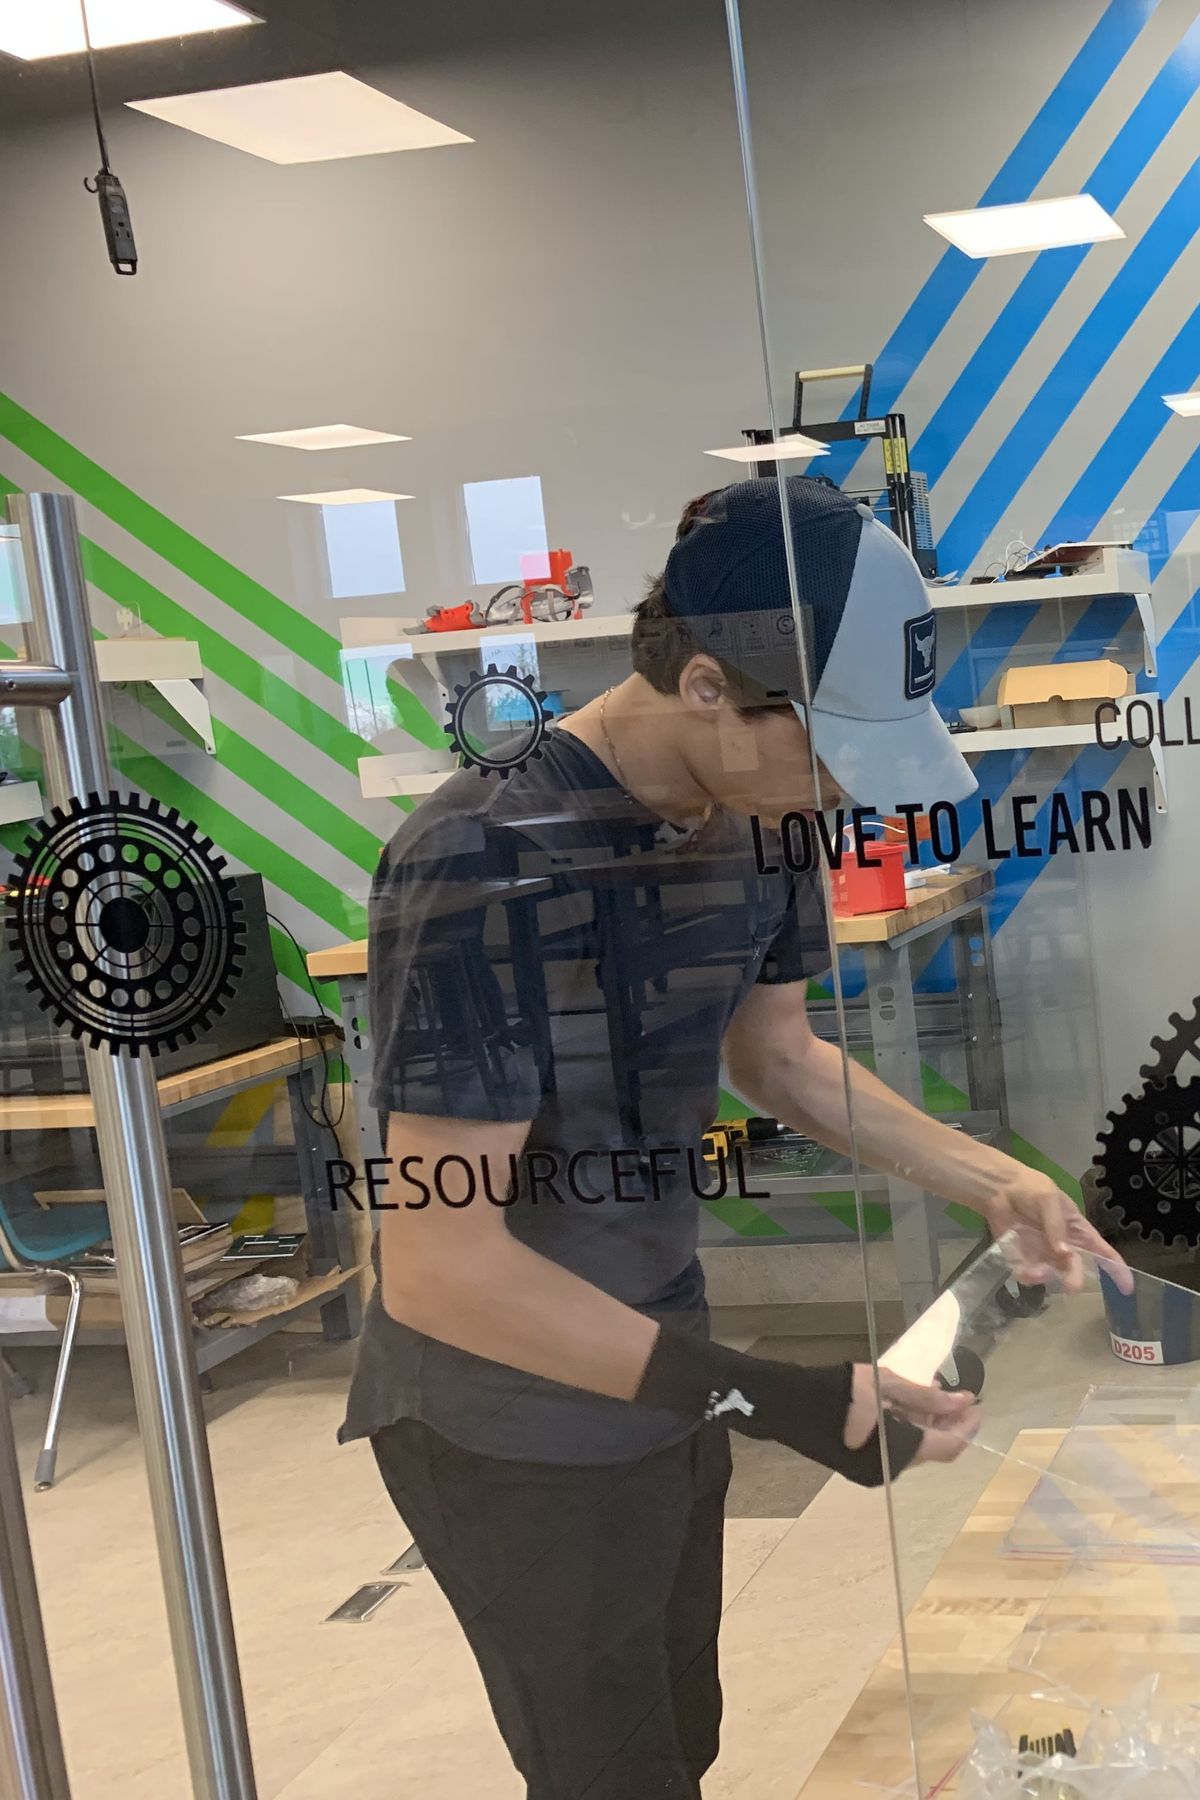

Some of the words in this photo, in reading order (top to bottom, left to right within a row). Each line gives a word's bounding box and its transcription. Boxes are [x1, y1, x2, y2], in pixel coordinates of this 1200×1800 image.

[749, 806, 882, 876] LOVE
[903, 800, 961, 865] TO
[981, 786, 1152, 860] LEARN
[325, 1144, 771, 1211] RESOURCEFUL
